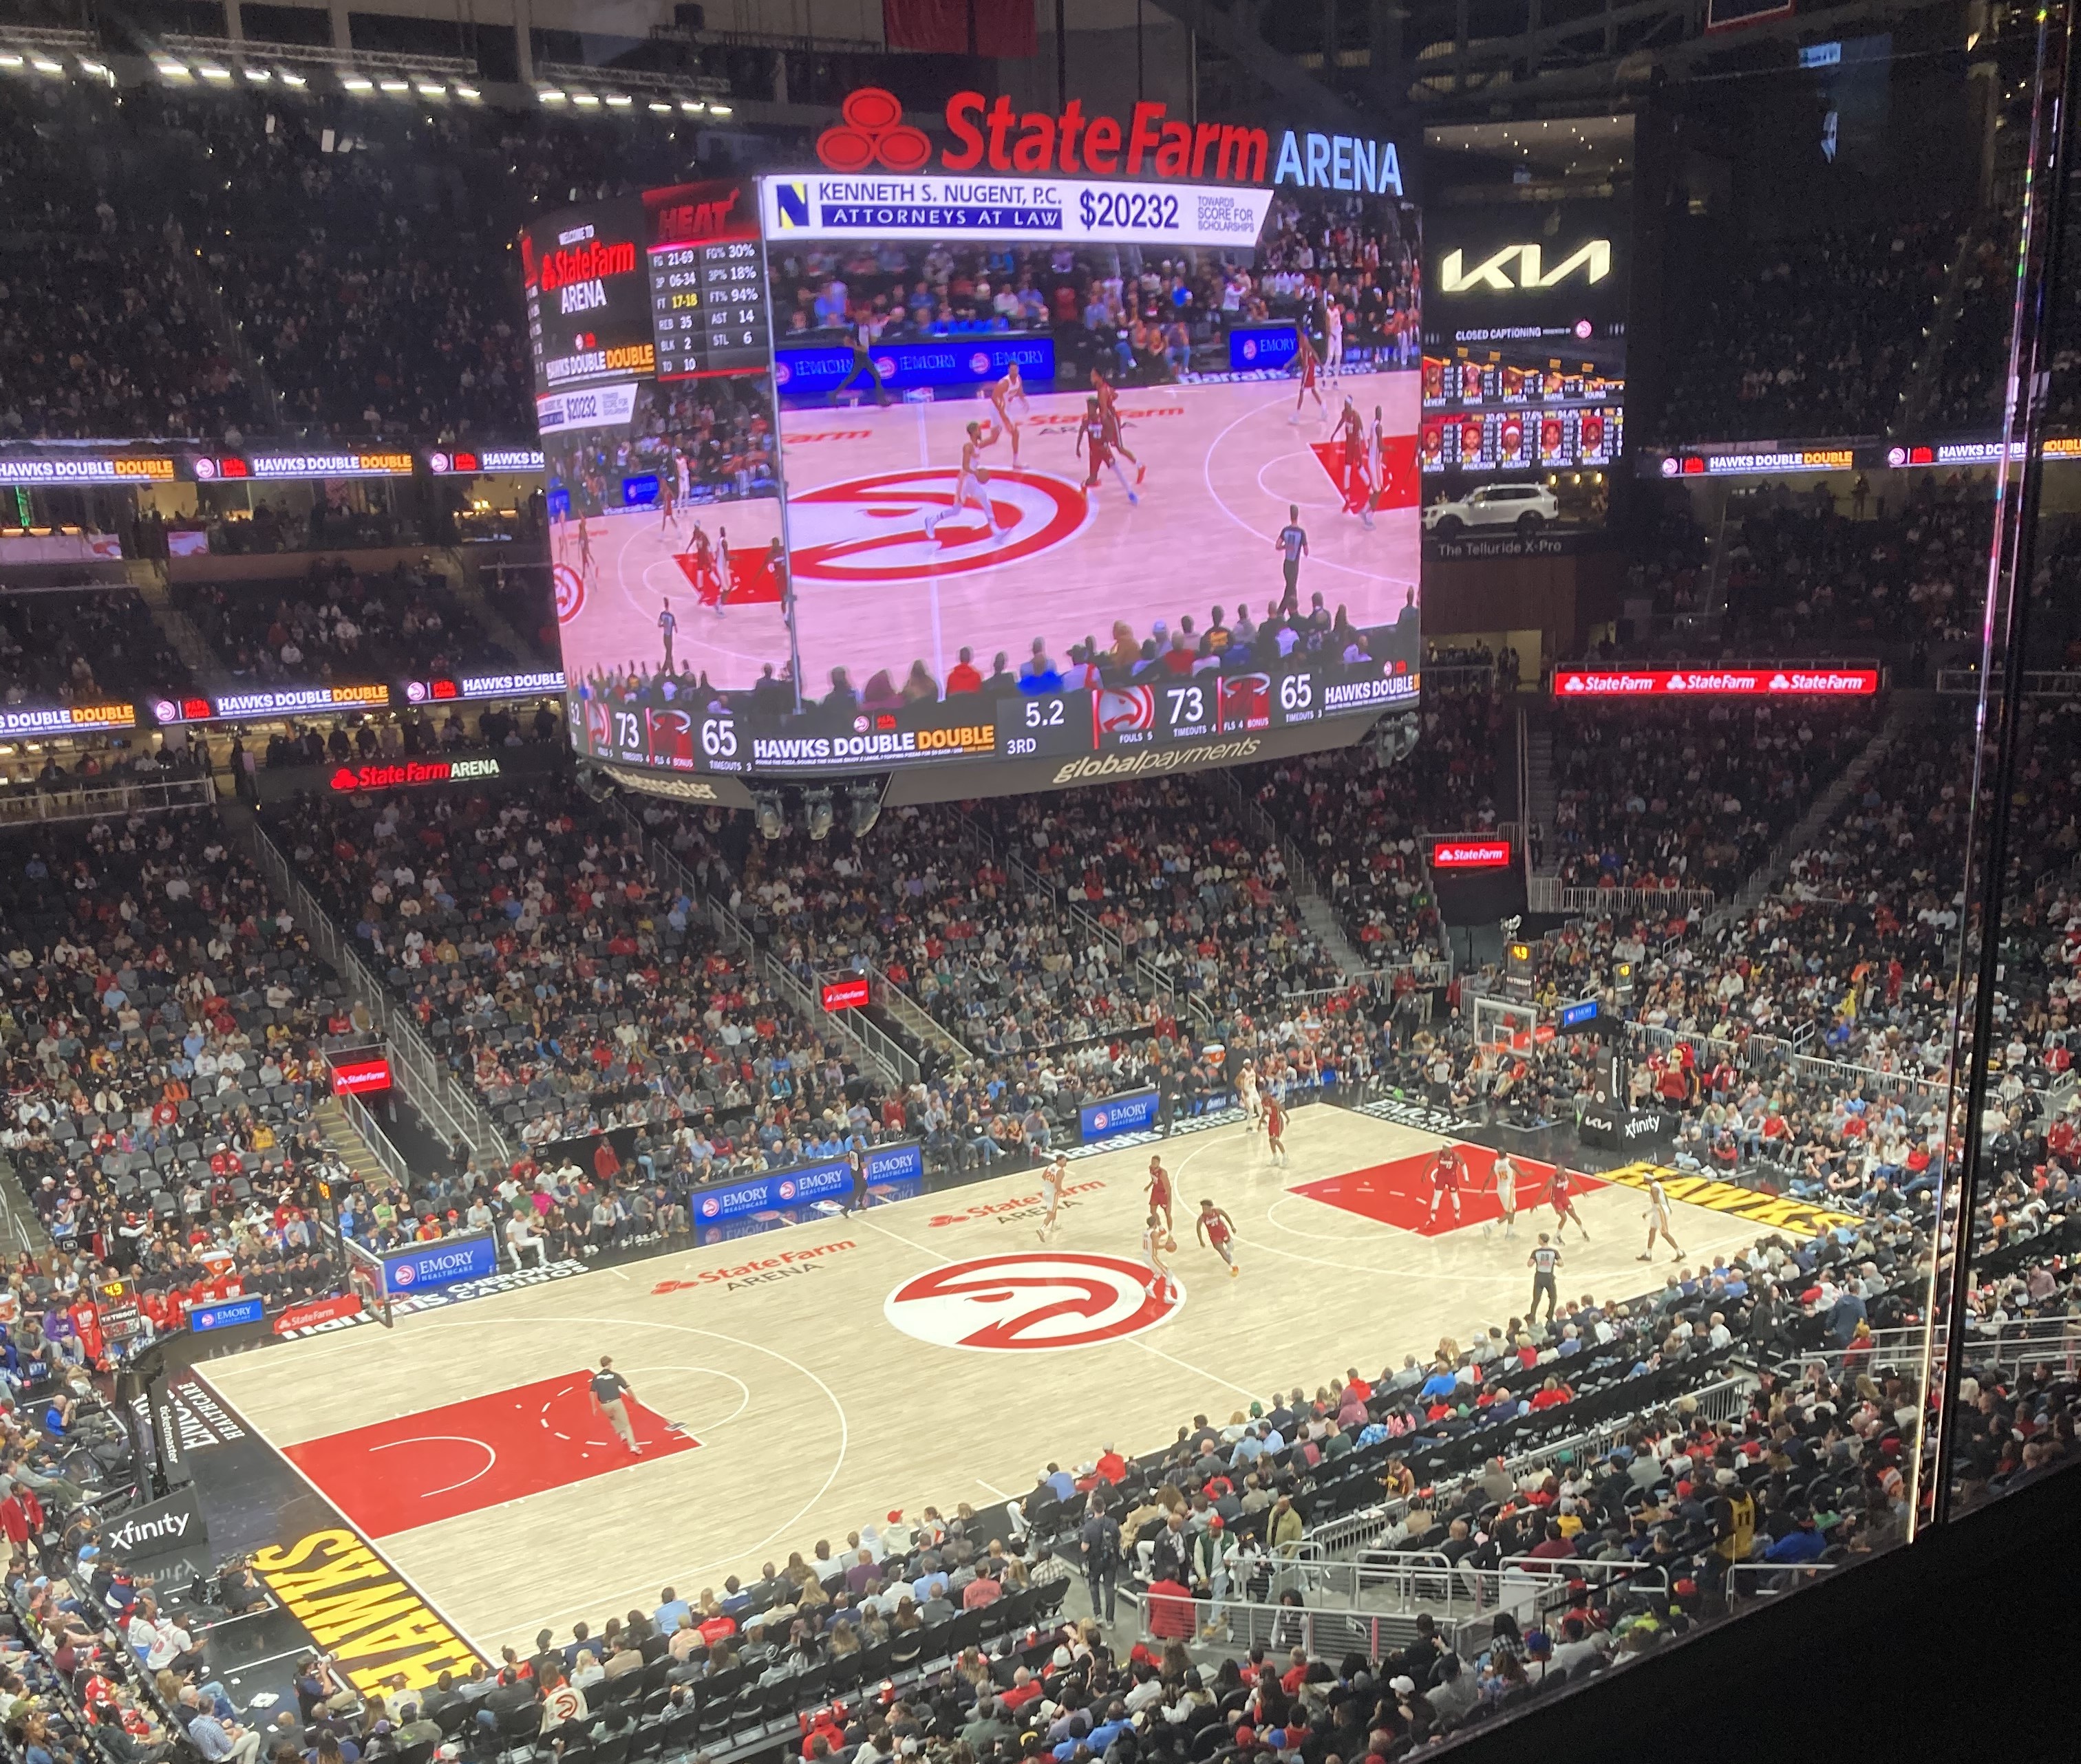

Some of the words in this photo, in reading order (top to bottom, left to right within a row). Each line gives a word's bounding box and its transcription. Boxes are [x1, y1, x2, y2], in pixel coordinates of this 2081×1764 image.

[1274, 129, 1404, 196] ARENA
[820, 182, 915, 202] KENNETH
[922, 184, 937, 202] S.
[945, 184, 1027, 206] NUGENT,
[1034, 187, 1062, 205] P.C.
[1198, 196, 1234, 207] TOWARDS
[659, 187, 740, 239] HEAT
[833, 209, 966, 225] ATTORNEYS
[978, 211, 1002, 225] AT
[1014, 212, 1058, 226] LAW
[1080, 189, 1179, 231] $20232
[1198, 208, 1231, 220] SCORE
[1234, 209, 1253, 221] FOR
[1198, 222, 1255, 233] SCHOLARSHIPS
[668, 250, 694, 266] 21-69
[728, 244, 756, 258] 30%
[730, 266, 756, 281] 18%
[561, 279, 607, 314] ARENA
[672, 293, 698, 310] 17-18
[731, 287, 758, 302] 94%
[680, 315, 692, 330] 35
[711, 311, 728, 325] AST
[738, 309, 755, 323] 14
[684, 336, 692, 350] 2
[713, 333, 729, 346] STL
[743, 331, 752, 345] 6
[1455, 329, 1488, 341] CLOSED
[1489, 327, 1541, 341] CAPTIONING
[1260, 338, 1296, 353] EMORY
[570, 351, 606, 374] DOUBLE
[606, 344, 654, 369] DOUBLE
[683, 357, 696, 372] 10
[1503, 394, 1528, 403] CAPELA
[1584, 391, 1607, 400] YOUNG
[483, 453, 526, 466] HAWKS
[1582, 456, 1610, 465] WIGGINS
[1710, 455, 1753, 468] HAWKS
[1755, 453, 1803, 466] DOUBLE
[1804, 451, 1853, 464] DOUBLE
[1939, 445, 1984, 458] HAWKS
[55, 460, 114, 475] DOUBLE
[115, 460, 173, 475] DOUBLE
[254, 457, 306, 472] HAWKS
[307, 455, 359, 470] DOUBLE
[360, 454, 412, 469] DOUBLE
[1462, 462, 1497, 471] ANDERSON
[1541, 458, 1574, 466] MITCHELL
[1438, 543, 1462, 557] The
[463, 676, 513, 692] HAWKS
[514, 671, 565, 688] DOUBLE
[1325, 681, 1371, 704] HAWKS
[1372, 675, 1413, 698] DOUBLE
[1586, 676, 1653, 691] StateFarm
[1687, 674, 1756, 690] StateFarm
[1791, 674, 1864, 690] StateFarm
[218, 693, 274, 711] HAWKS
[276, 689, 331, 707] DOUBLE
[332, 685, 387, 702] DOUBLE
[1166, 687, 1204, 725] 73
[1280, 674, 1312, 709] 65
[8, 710, 70, 727] DOUBLE
[72, 704, 135, 722] DOUBLE
[1025, 699, 1065, 728] 5.2
[615, 712, 639, 749] 73
[702, 718, 737, 756] 65
[1119, 733, 1142, 744] FOULS
[1173, 724, 1207, 737] TIMEOUTS
[1210, 723, 1217, 733] 4
[1224, 720, 1236, 731] FLS
[1238, 719, 1244, 729] 4
[1247, 717, 1269, 728] BONUS
[1285, 710, 1314, 723] TIMEOUTS
[754, 738, 831, 758] HAWKS
[833, 731, 915, 757] DOUBLE
[917, 724, 995, 750] DOUBLE
[1007, 738, 1036, 755] 3RD
[451, 759, 500, 776] ARENA
[1053, 737, 1261, 784] globalpayments
[1453, 848, 1504, 860] StateFarm
[1111, 1102, 1147, 1121] EMORY
[1625, 1115, 1660, 1139] xfinity
[872, 1154, 914, 1174] EMORY
[799, 1170, 842, 1190] EMORY
[1045, 1172, 1055, 1183] 20
[723, 1185, 769, 1207] EMORY
[800, 1181, 842, 1197] HEALTHCARE
[724, 1198, 767, 1214] HEALTHCARE
[419, 1250, 474, 1274] EMORY
[697, 1240, 857, 1283] StateFarm
[421, 1265, 474, 1281] HEALTHCARE
[447, 1258, 581, 1293] CHEROKEE
[727, 1262, 824, 1292] ARENA
[455, 1266, 589, 1300] CASINOS
[113, 1309, 136, 1321] TISSOT
[217, 1305, 251, 1320] EMORY
[292, 1307, 334, 1327] StateFarm
[160, 1405, 178, 1463] ticketmaster
[108, 1512, 189, 1549] xfinity
[251, 1528, 489, 1699] HAWKS
